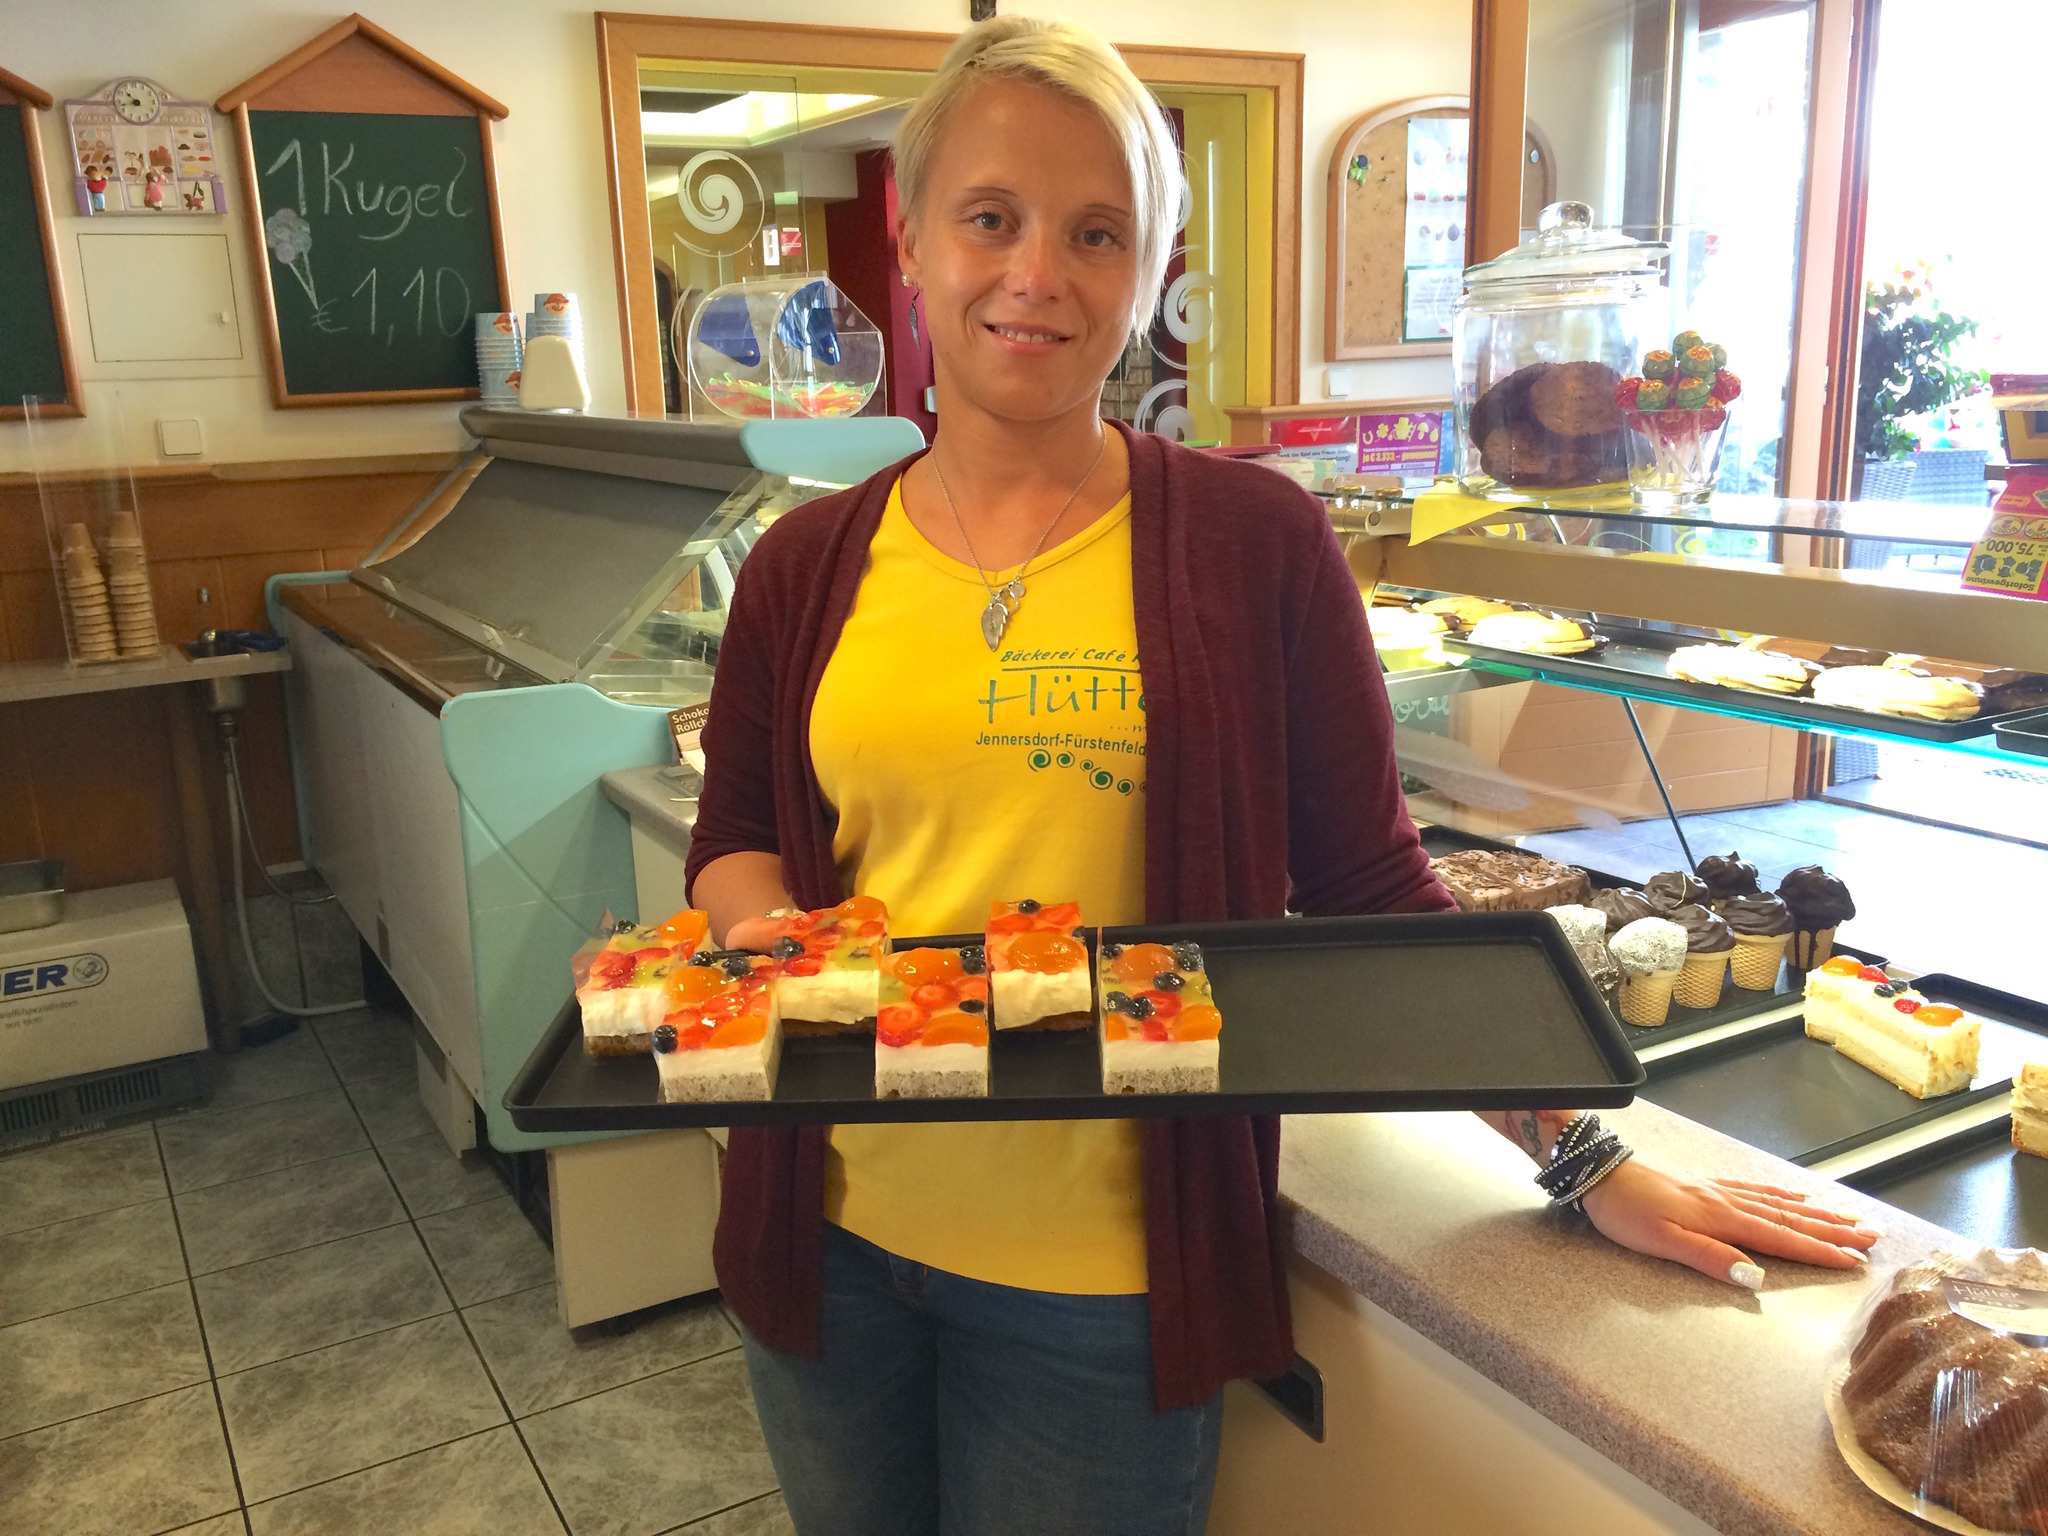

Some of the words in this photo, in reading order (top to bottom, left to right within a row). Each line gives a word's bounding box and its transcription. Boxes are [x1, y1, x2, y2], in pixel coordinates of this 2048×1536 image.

[265, 137, 307, 217] 1
[321, 141, 474, 241] Kugel
[310, 297, 349, 333] €
[351, 265, 471, 346] 1,10
[1965, 575, 2036, 592] Sofortgewinne
[1000, 647, 1079, 663] Bäckerei
[1082, 648, 1127, 663] Café
[671, 707, 710, 724] Schoko
[0, 964, 69, 996] ER
[1952, 1284, 2020, 1299] Hütter
